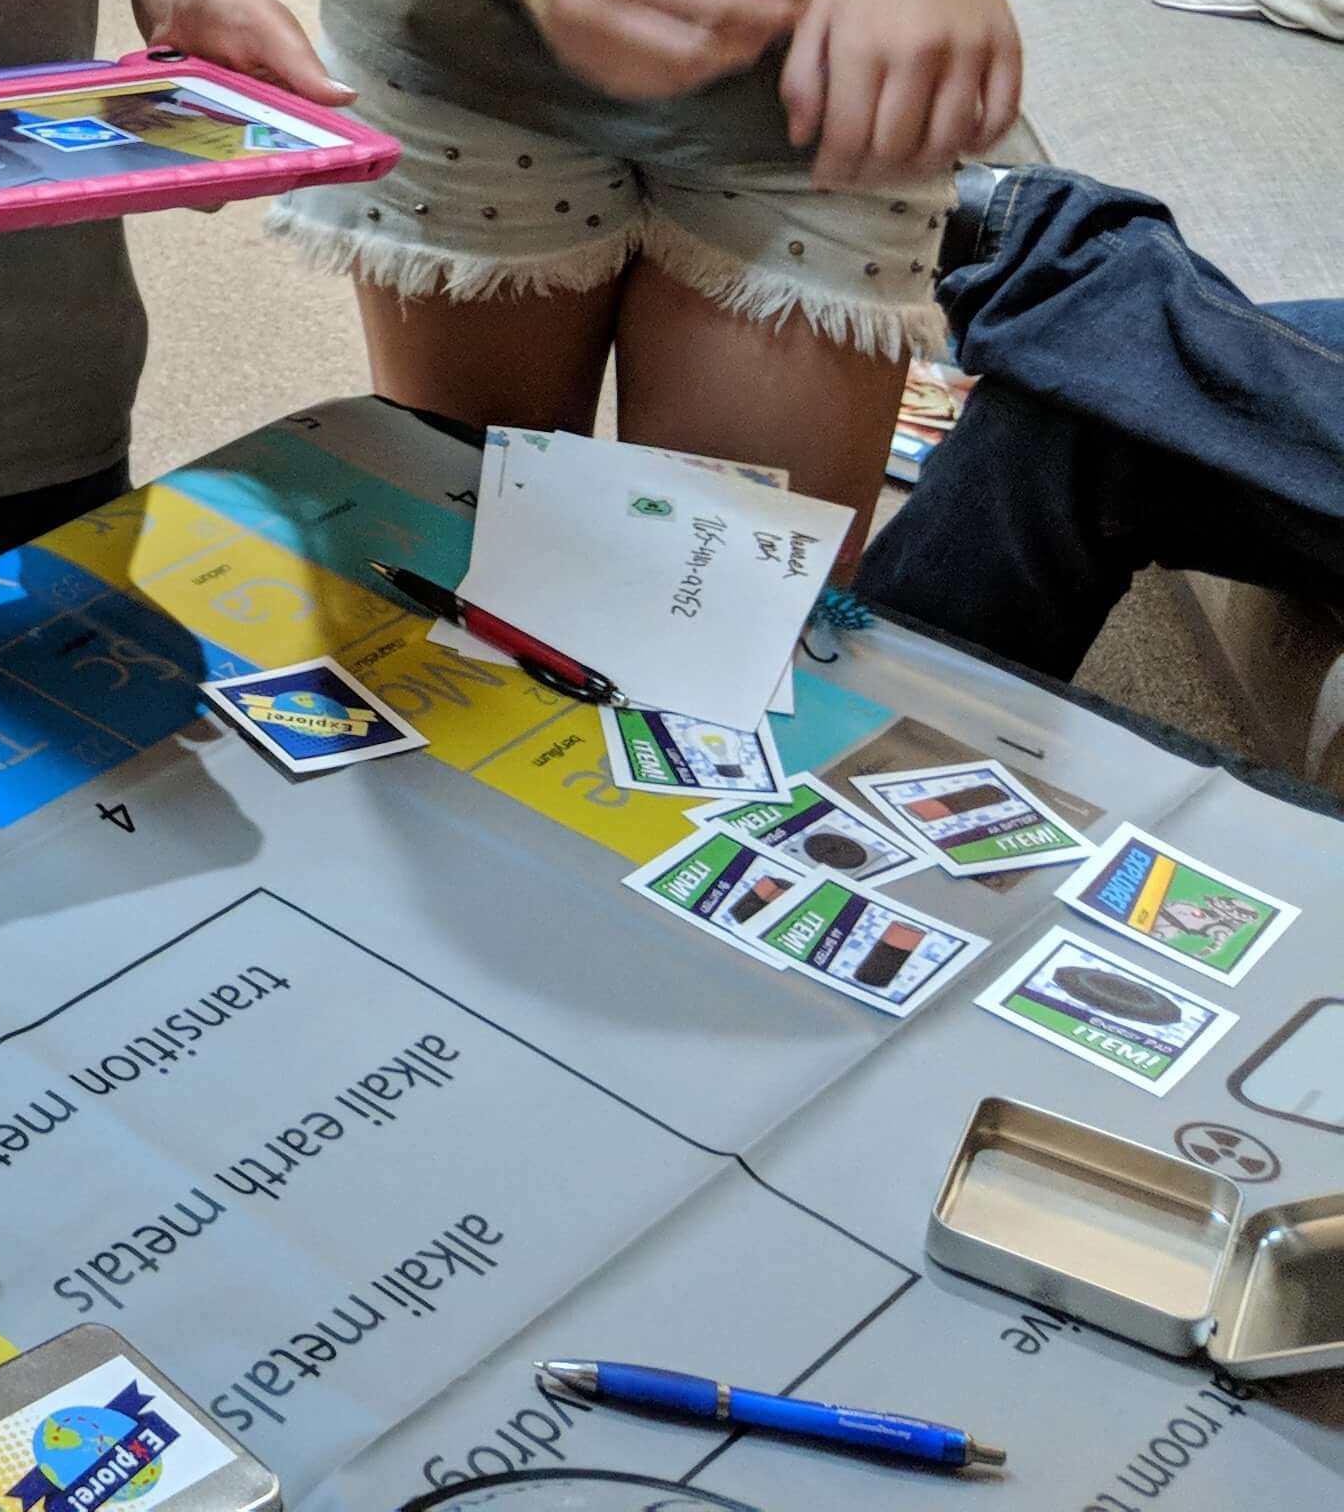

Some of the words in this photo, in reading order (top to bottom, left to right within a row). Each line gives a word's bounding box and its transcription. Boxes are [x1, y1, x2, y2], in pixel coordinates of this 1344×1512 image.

[211, 578, 316, 626] Ca
[266, 710, 355, 734] Explore!
[531, 735, 586, 767] beryllium
[631, 739, 671, 781] ITEM!
[95, 802, 136, 833] 4
[996, 826, 1061, 853] ITEM!
[1000, 814, 1041, 834] BATTERY
[664, 858, 713, 902] ITEM!
[1098, 848, 1151, 914] EXPLORE!
[778, 910, 826, 955] ITEM!
[70, 964, 292, 1098] transition
[1072, 1024, 1161, 1071] ITEM!
[1089, 1016, 1143, 1043] ENERGY
[1144, 1037, 1173, 1055] PAD
[353, 1032, 461, 1128] alkali
[216, 1110, 345, 1201] earth
[54, 1188, 227, 1315] metals
[371, 1212, 504, 1320] alkali
[211, 1292, 389, 1433] metals
[67, 1428, 166, 1512] Explore!
[1117, 1405, 1224, 1498] room
